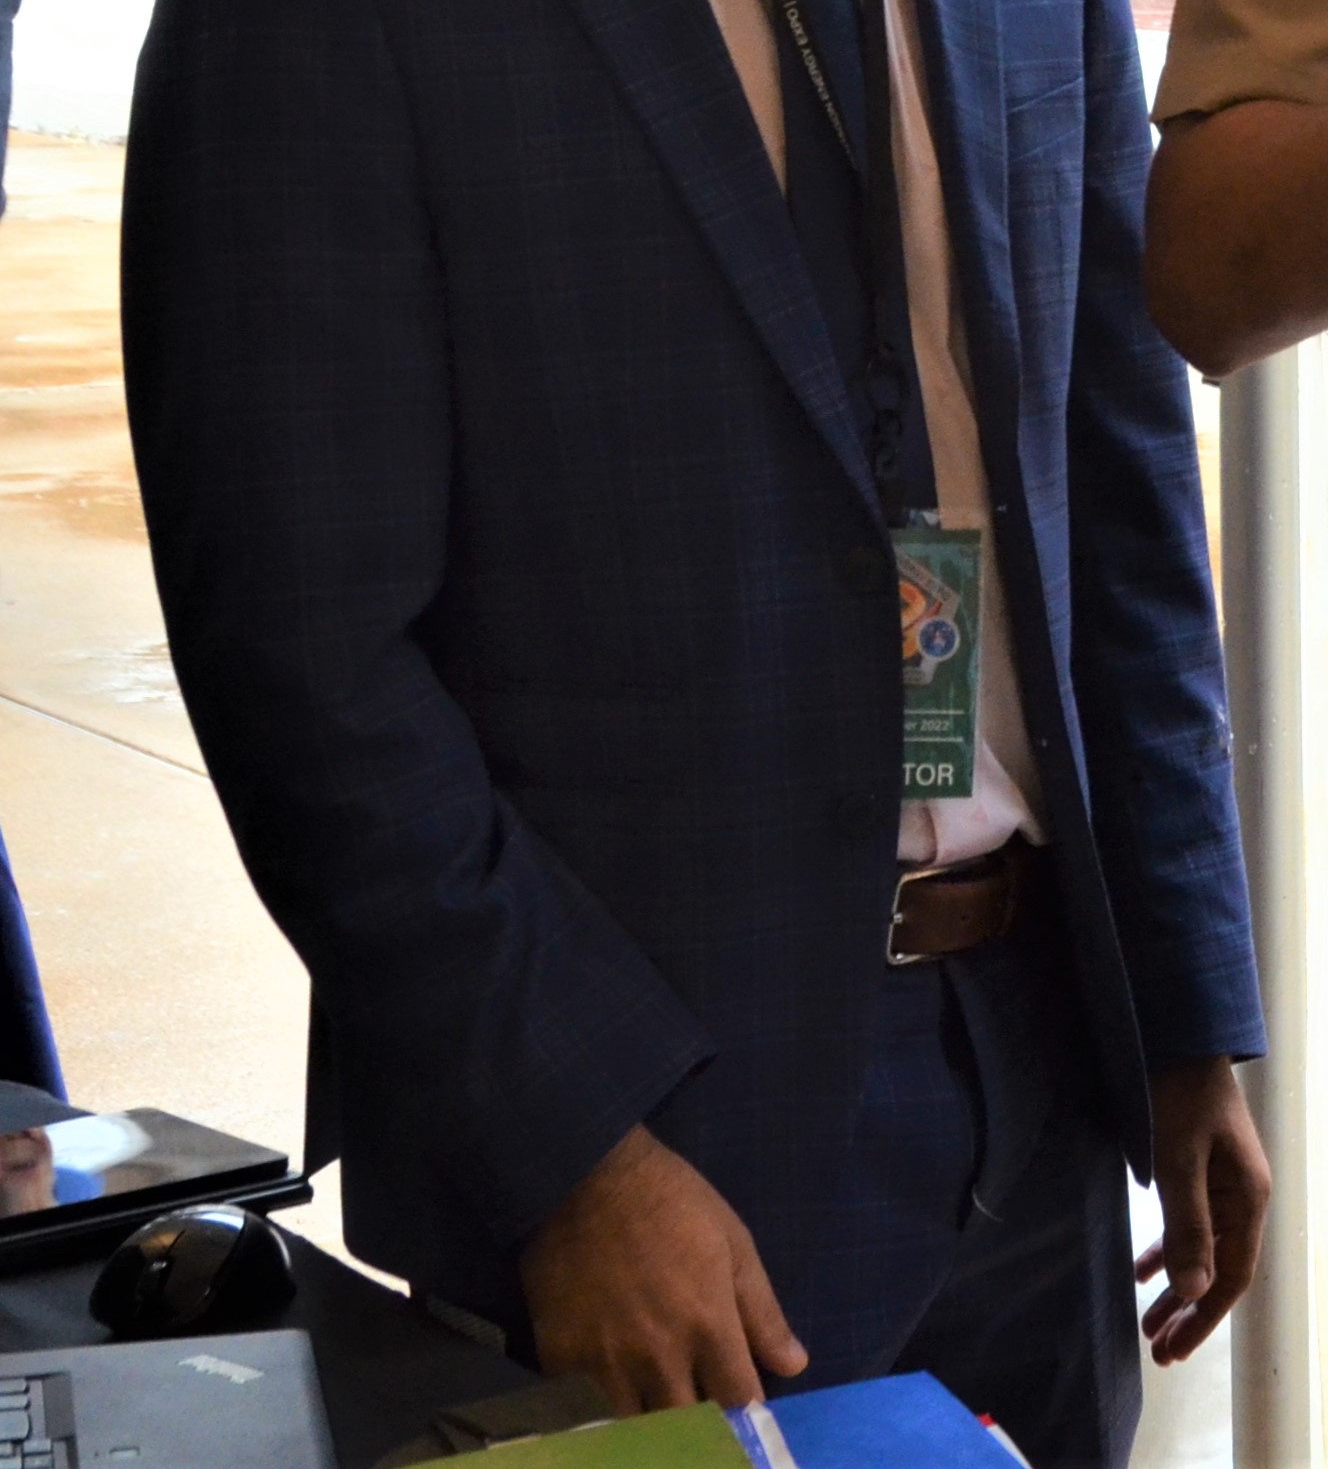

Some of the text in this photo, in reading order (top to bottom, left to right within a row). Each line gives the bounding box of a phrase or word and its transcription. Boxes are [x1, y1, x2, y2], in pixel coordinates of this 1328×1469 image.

[786, 8, 809, 46] EXPO
[801, 48, 830, 101] ENERGY
[920, 719, 950, 731] 2022
[902, 763, 954, 786] TOR
